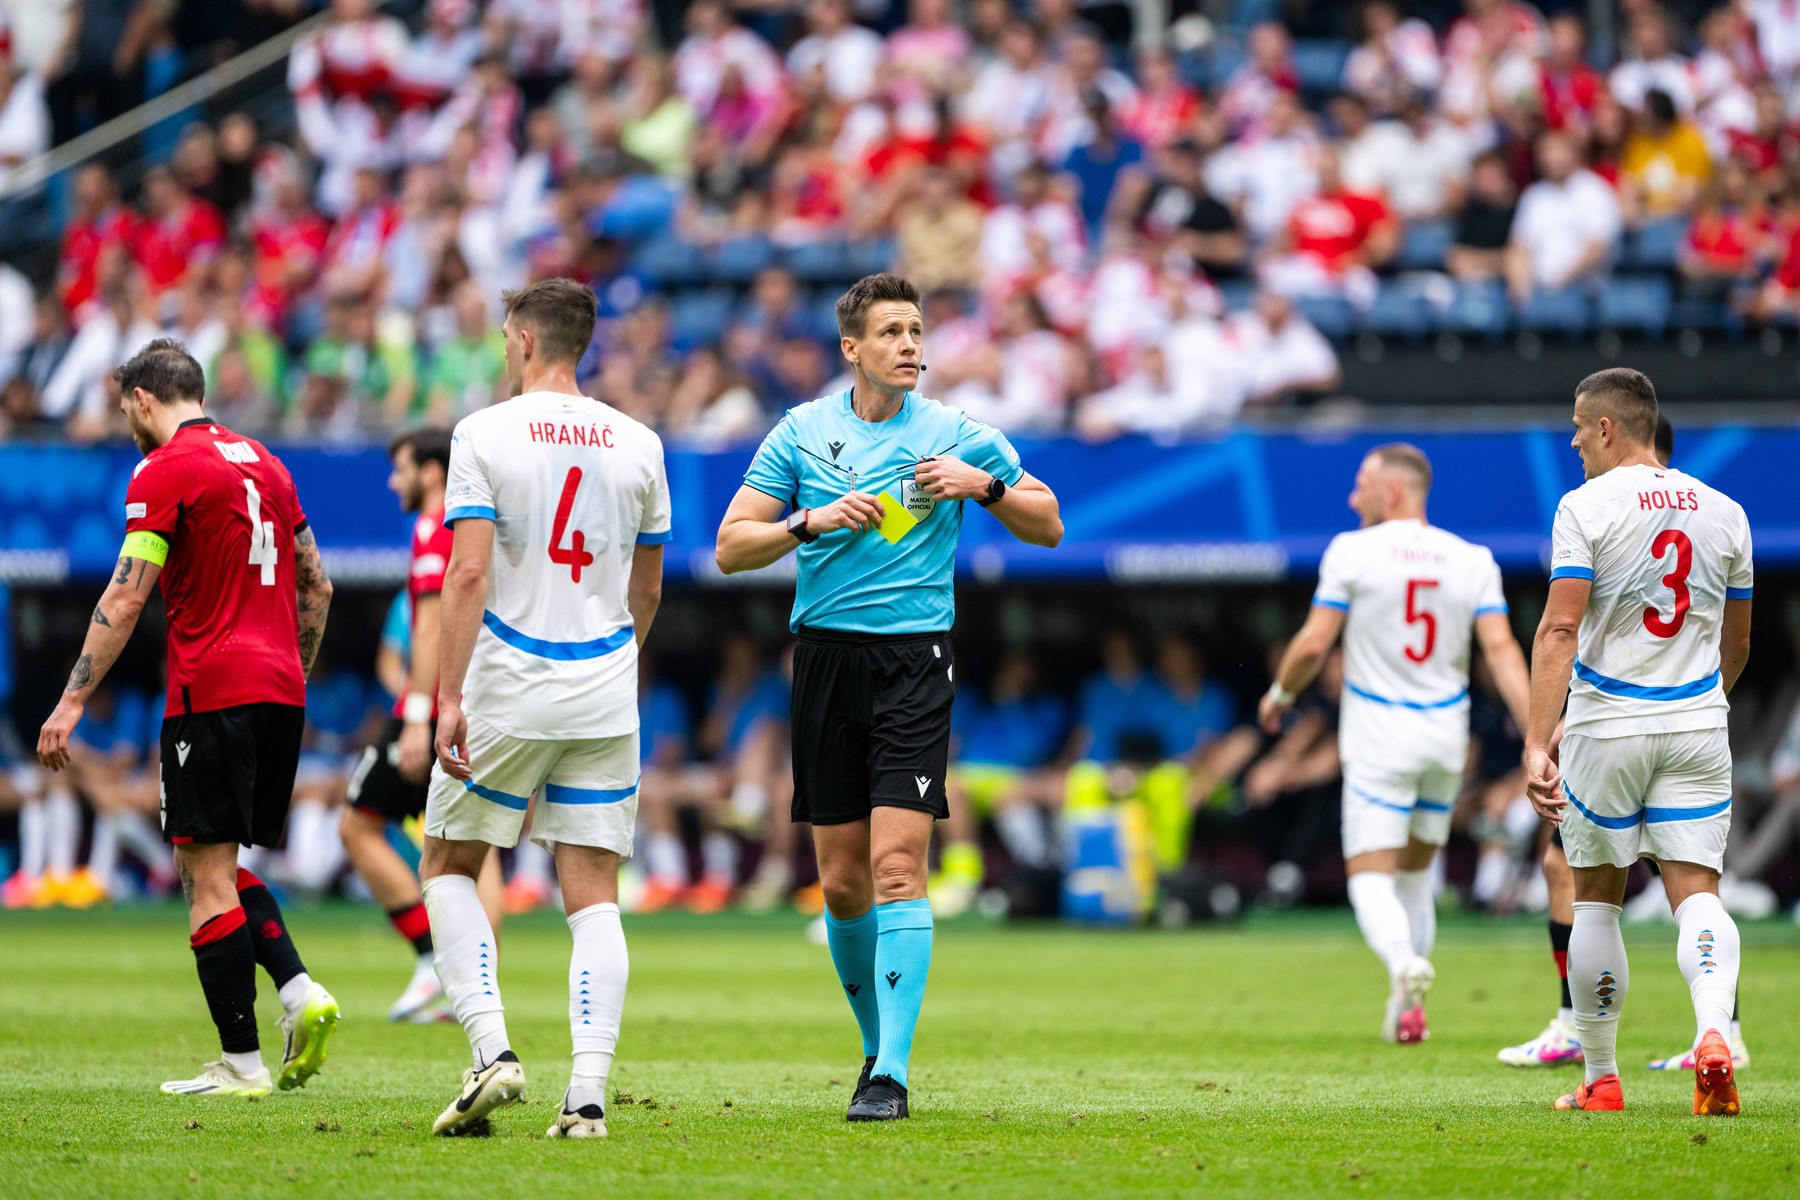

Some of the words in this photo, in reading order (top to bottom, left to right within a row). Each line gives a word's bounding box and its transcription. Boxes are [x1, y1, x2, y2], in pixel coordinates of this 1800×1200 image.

[529, 422, 615, 449] HRANÁČ
[243, 478, 278, 587] 4
[548, 465, 595, 584] 4
[1637, 488, 1699, 511] HOLEŠ
[1404, 578, 1440, 664] 5
[1642, 528, 1693, 639] 3
